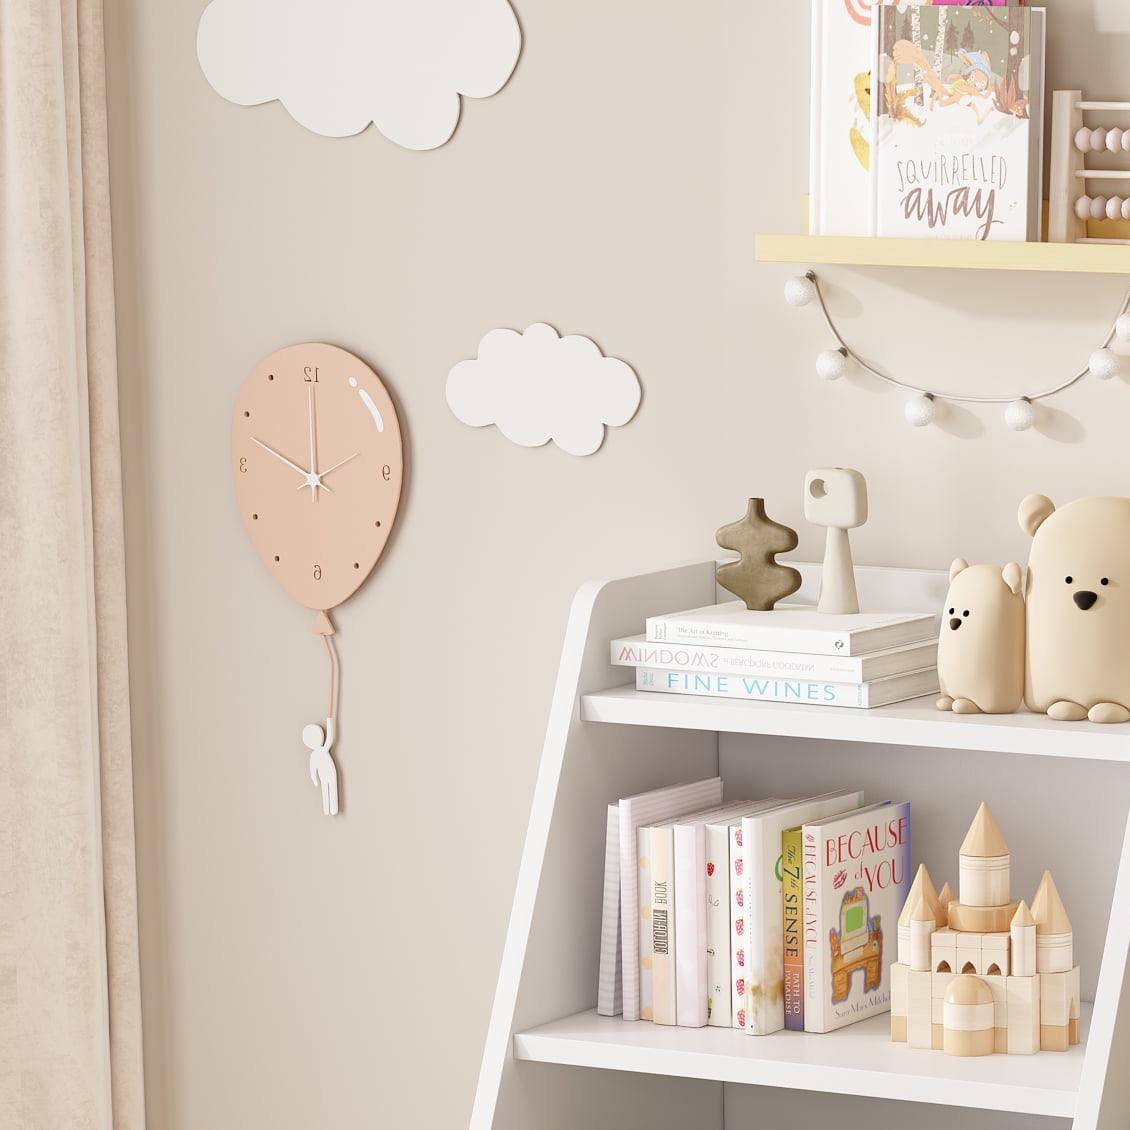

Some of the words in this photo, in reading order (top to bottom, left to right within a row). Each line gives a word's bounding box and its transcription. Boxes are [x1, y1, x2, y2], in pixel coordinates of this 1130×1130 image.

[897, 153, 1007, 192] SQUIRRELLED
[900, 186, 1005, 240] away
[667, 672, 729, 692] FINE
[742, 678, 836, 701] WINES
[826, 817, 907, 867] BECAUSE
[805, 845, 816, 904] BECAUSE
[864, 855, 905, 892] YOU
[785, 893, 798, 957] SENSE
